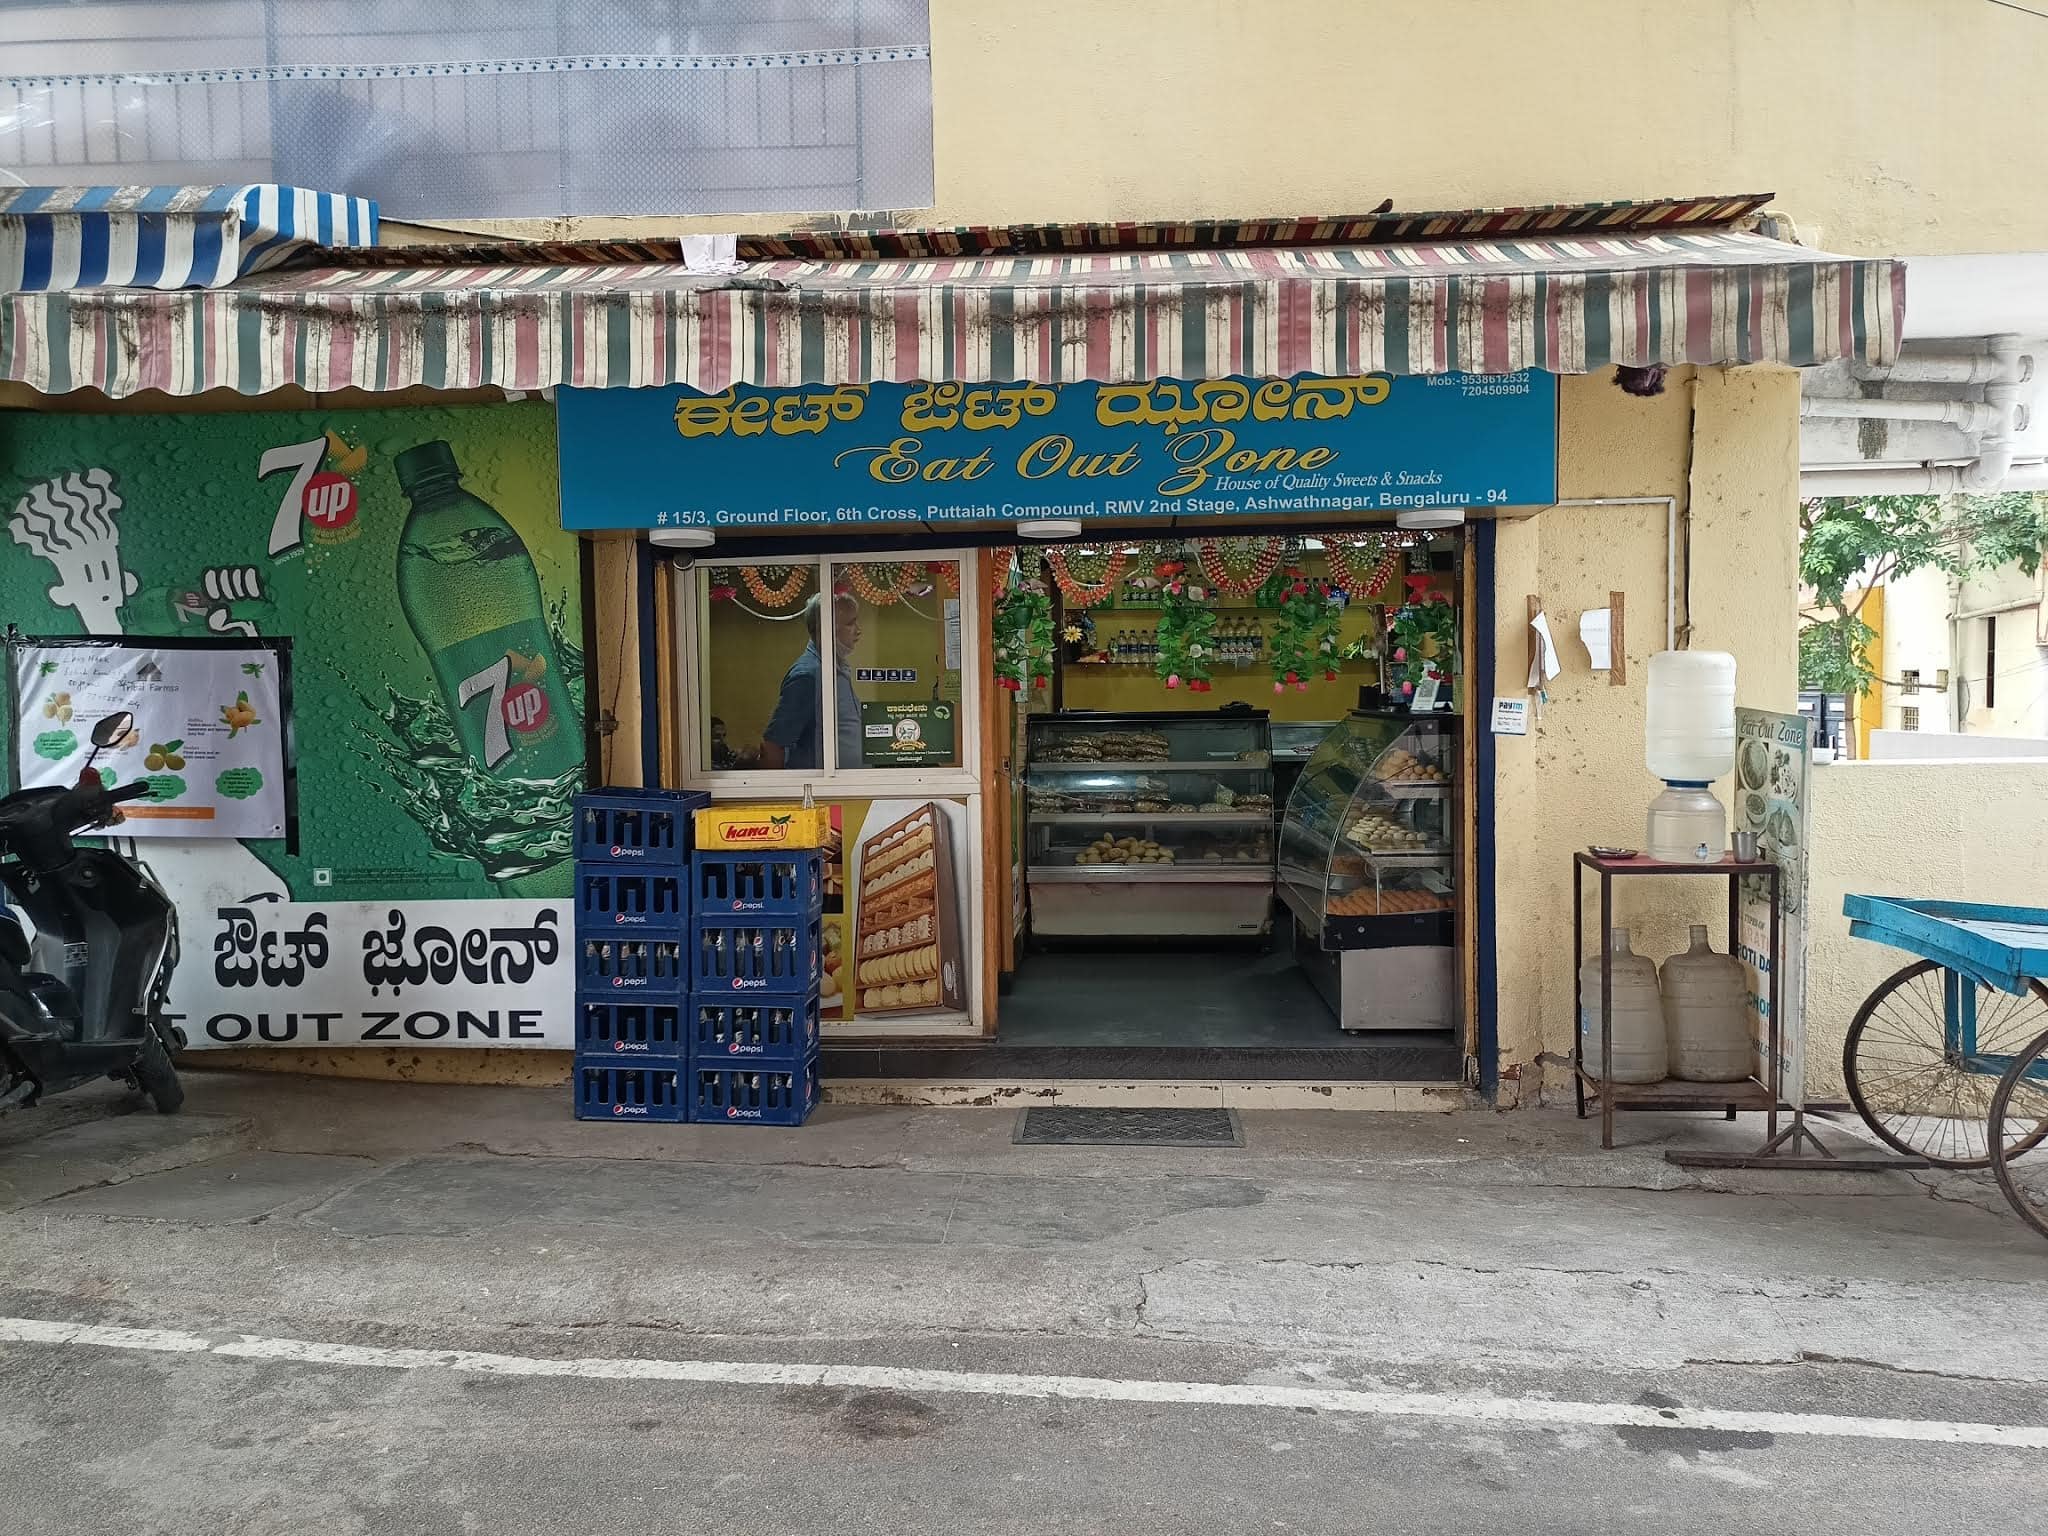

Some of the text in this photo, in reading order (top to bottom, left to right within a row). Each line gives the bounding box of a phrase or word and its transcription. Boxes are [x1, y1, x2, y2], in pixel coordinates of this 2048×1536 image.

[1462, 384, 1530, 397] 7204509904
[834, 428, 1340, 496] Eat Out Zone
[1214, 470, 1443, 491] House of Quality Sweets & Snacks
[657, 511, 668, 524] #
[673, 510, 711, 526] 15/3,
[715, 508, 779, 523] Ground
[783, 508, 832, 523] Floor,
[836, 507, 863, 520] 6th
[867, 506, 923, 521] Cross,
[927, 504, 996, 519] Puttaiah
[1001, 501, 1100, 519] Compound,
[1105, 500, 1144, 514] RMV
[1150, 499, 1181, 513] 2nd
[1186, 498, 1240, 515] Stage,
[1244, 495, 1373, 513] Ashwathnagar,
[1379, 491, 1470, 508] Bengaluru
[1487, 490, 1508, 504] 94
[1777, 720, 1802, 745] Zone
[205, 1009, 546, 1042] OUT ZONE
